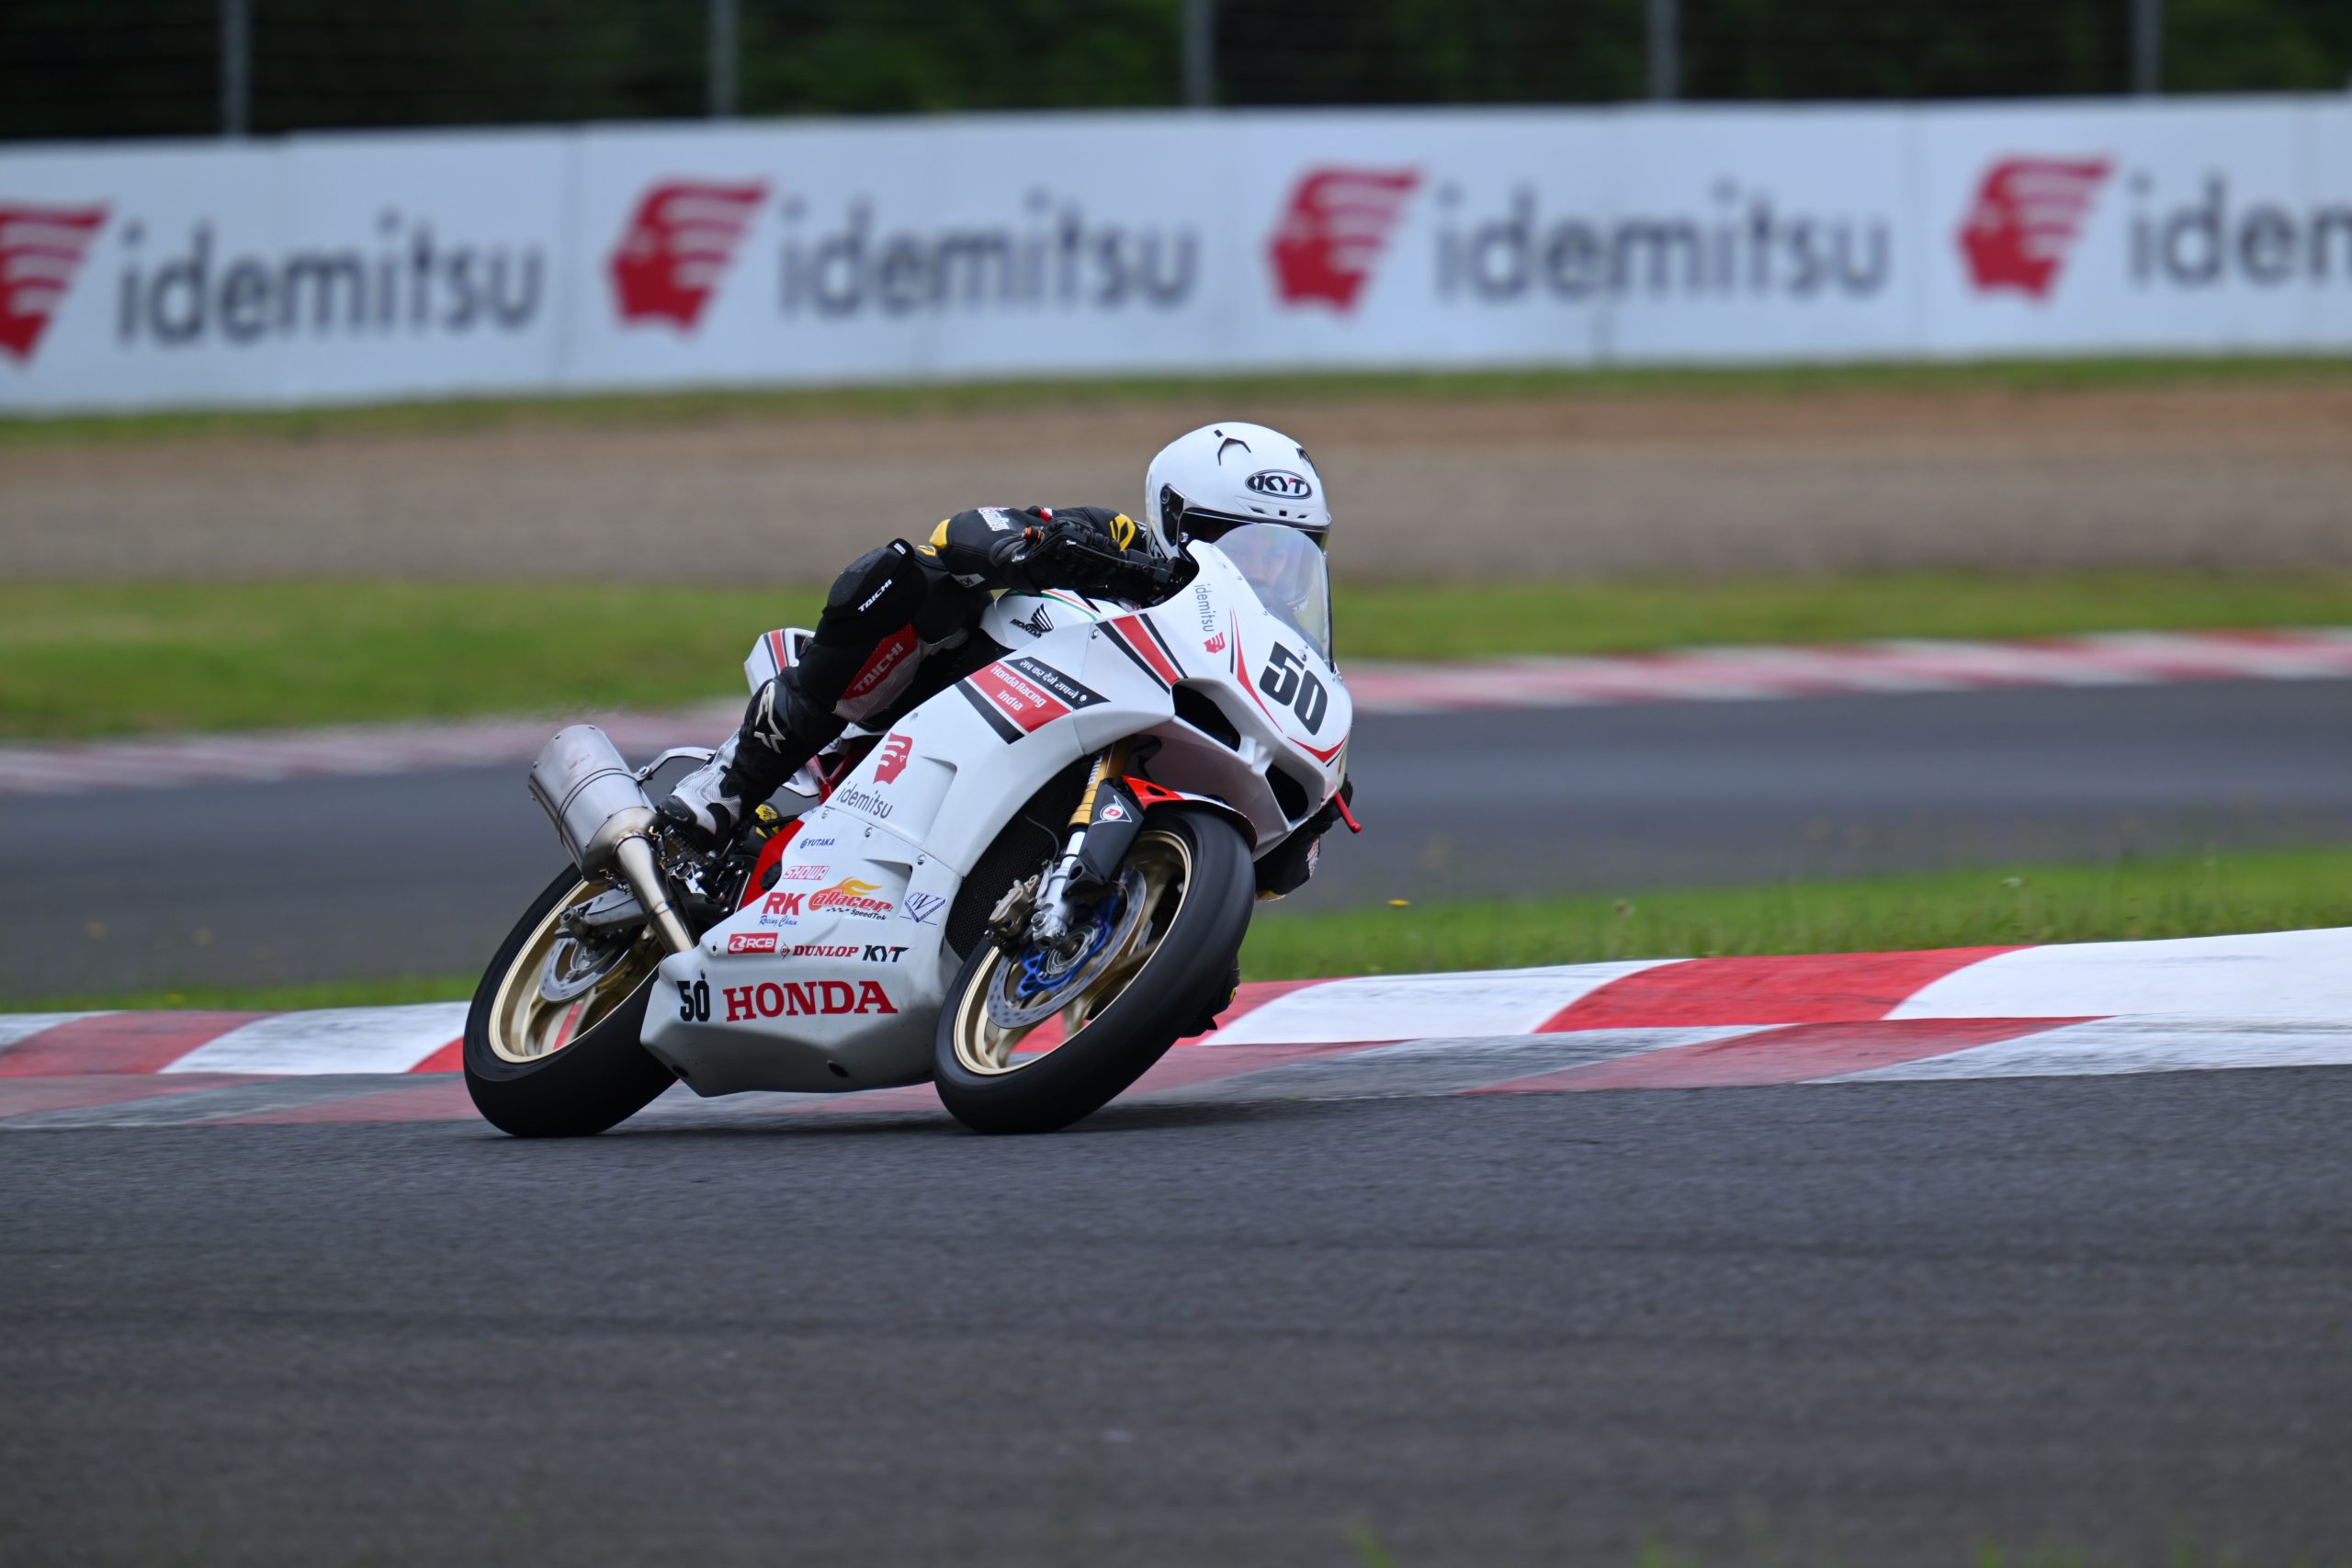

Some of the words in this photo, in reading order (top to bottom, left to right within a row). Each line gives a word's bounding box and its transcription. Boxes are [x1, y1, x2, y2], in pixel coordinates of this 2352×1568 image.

[778, 187, 1197, 318] idemitsu
[1435, 178, 1889, 301] idemitsu
[118, 206, 543, 344] idemitsu
[1255, 474, 1306, 494] KYT
[858, 579, 892, 613] TAICHI
[1194, 583, 1216, 632] idemitsu
[1010, 618, 1042, 638] HONDA
[854, 642, 903, 692] TAICHI
[990, 665, 1020, 687] Honda
[1016, 682, 1047, 708] Racing
[997, 690, 1024, 711] India
[1260, 641, 1328, 735] 50
[837, 781, 893, 818] idemitsu
[808, 838, 835, 846] YUTAKA
[782, 865, 830, 880] SHOWA
[762, 892, 807, 916] RK
[850, 908, 887, 920] SpeedTek
[759, 915, 778, 926] Racing
[746, 938, 775, 949] RCB
[793, 945, 859, 957] DUNLOP
[863, 944, 910, 963] KYT
[676, 980, 710, 1021] 50
[723, 980, 899, 1021] HONDA
